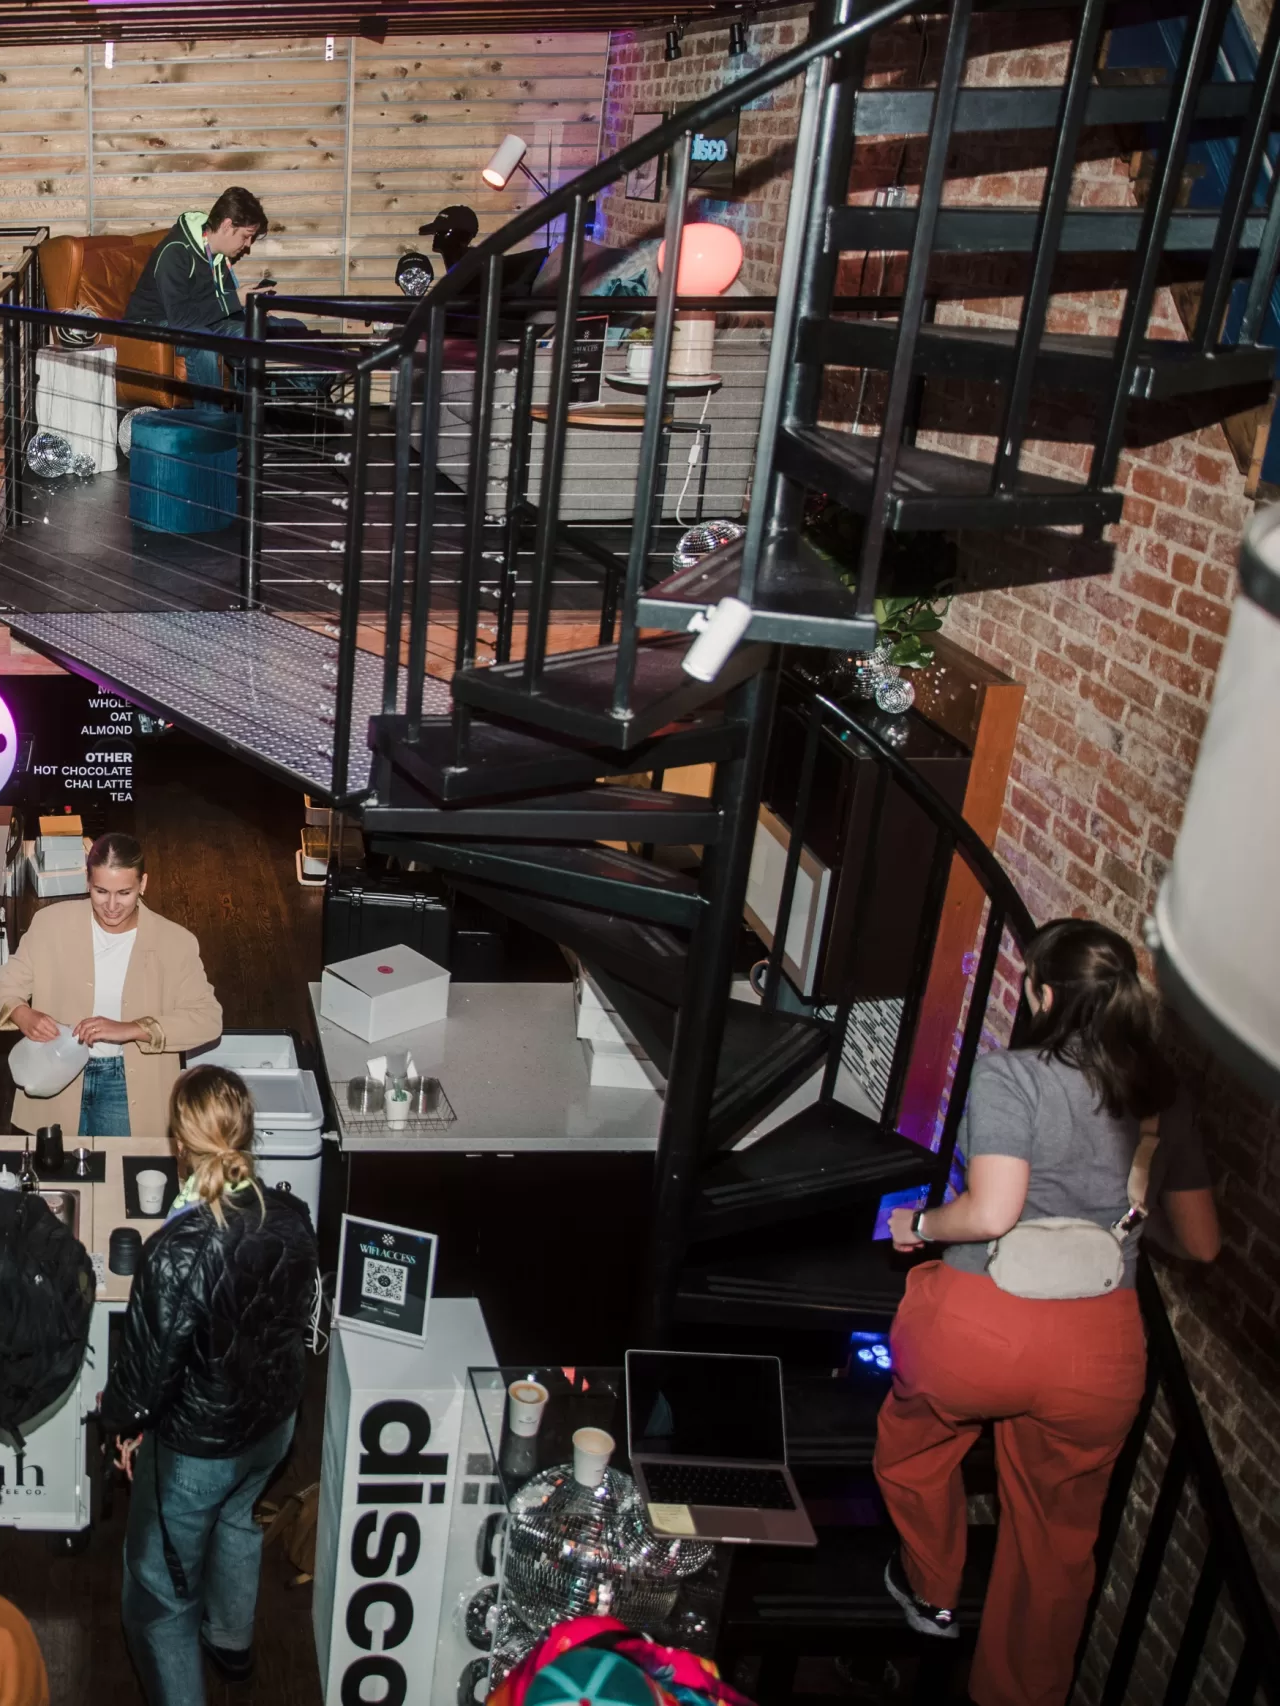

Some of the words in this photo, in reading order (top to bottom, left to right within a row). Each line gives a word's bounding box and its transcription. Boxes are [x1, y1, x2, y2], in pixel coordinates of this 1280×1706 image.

[88, 698, 132, 708] WHOLE
[110, 712, 133, 722] OAT
[80, 725, 133, 735] ALMOND
[85, 752, 133, 763] OTHER
[33, 765, 58, 775] HOT
[61, 766, 133, 776] CHOCOLATE
[64, 779, 93, 789] CHAI
[96, 779, 133, 789] LATTE
[110, 792, 133, 802] TEA
[359, 1243, 380, 1256] WIFI
[380, 1249, 417, 1265] ACCESS
[339, 1398, 449, 1706] disco
